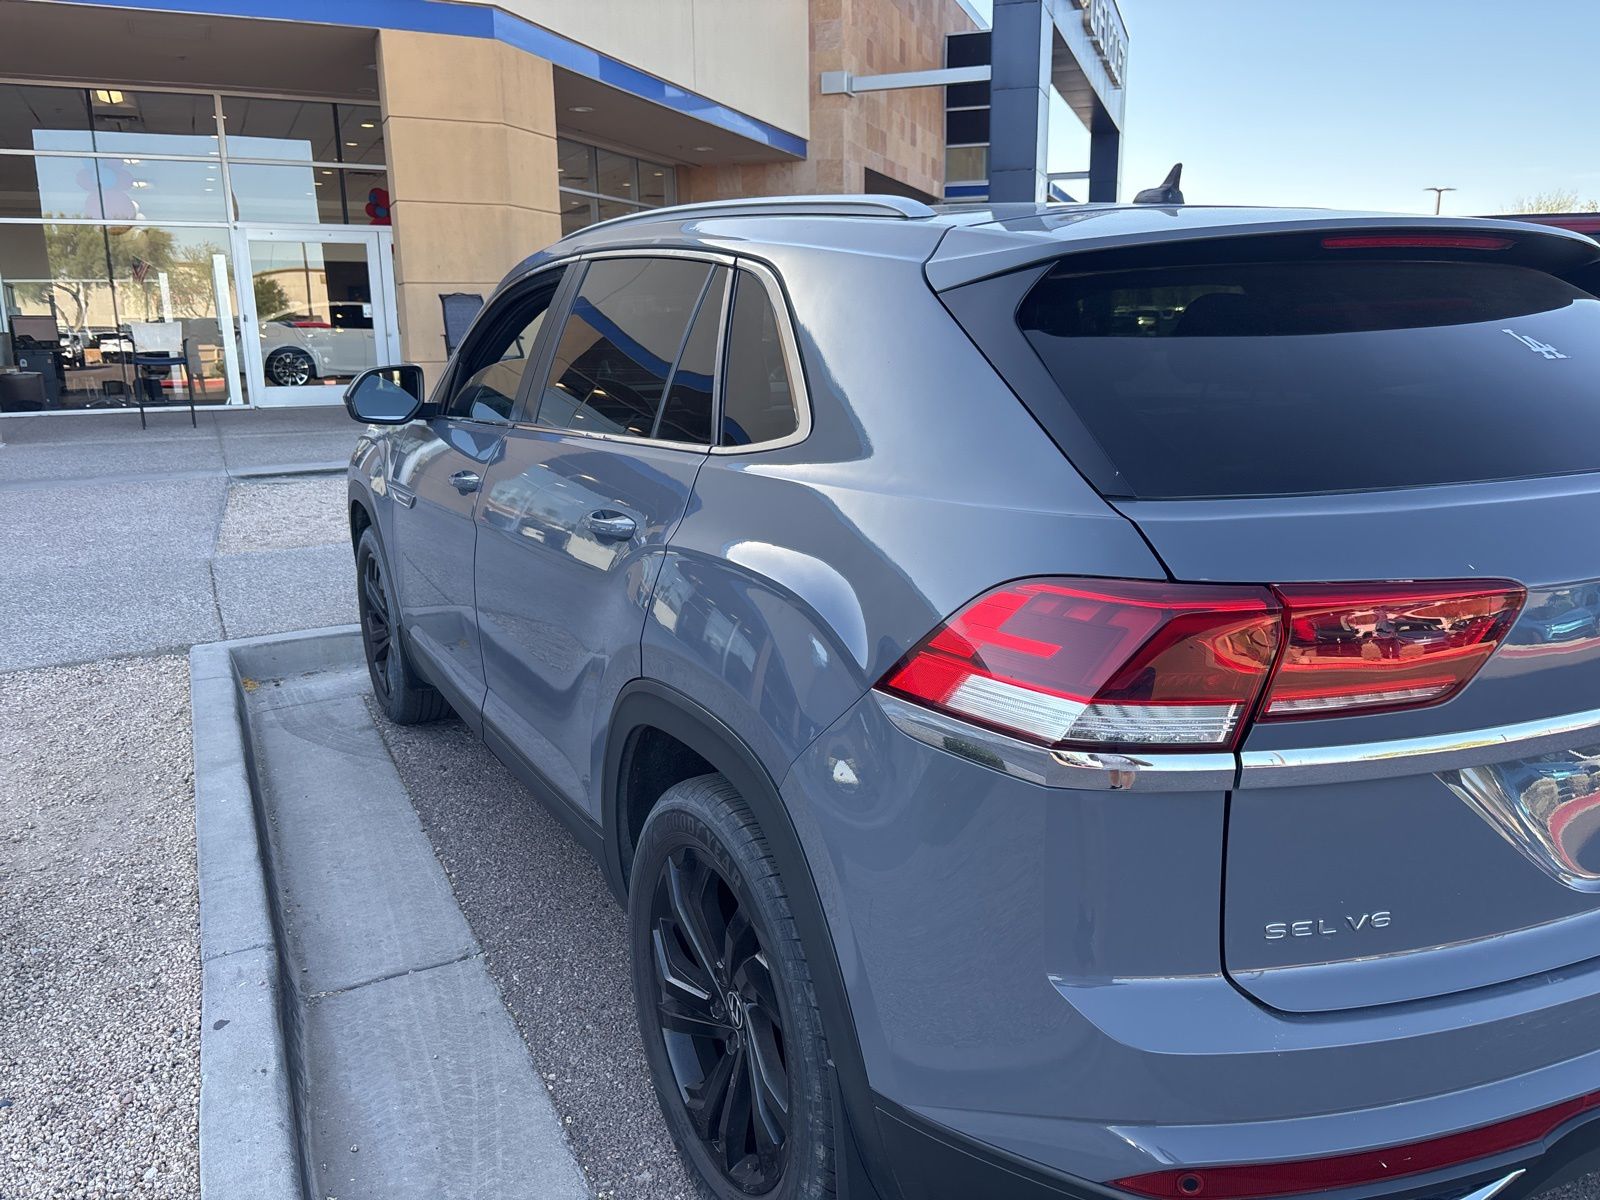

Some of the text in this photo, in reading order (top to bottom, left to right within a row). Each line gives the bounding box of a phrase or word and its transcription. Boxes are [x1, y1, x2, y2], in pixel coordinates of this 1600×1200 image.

[1501, 328, 1568, 360] LA
[1264, 910, 1392, 940] SEL V6
